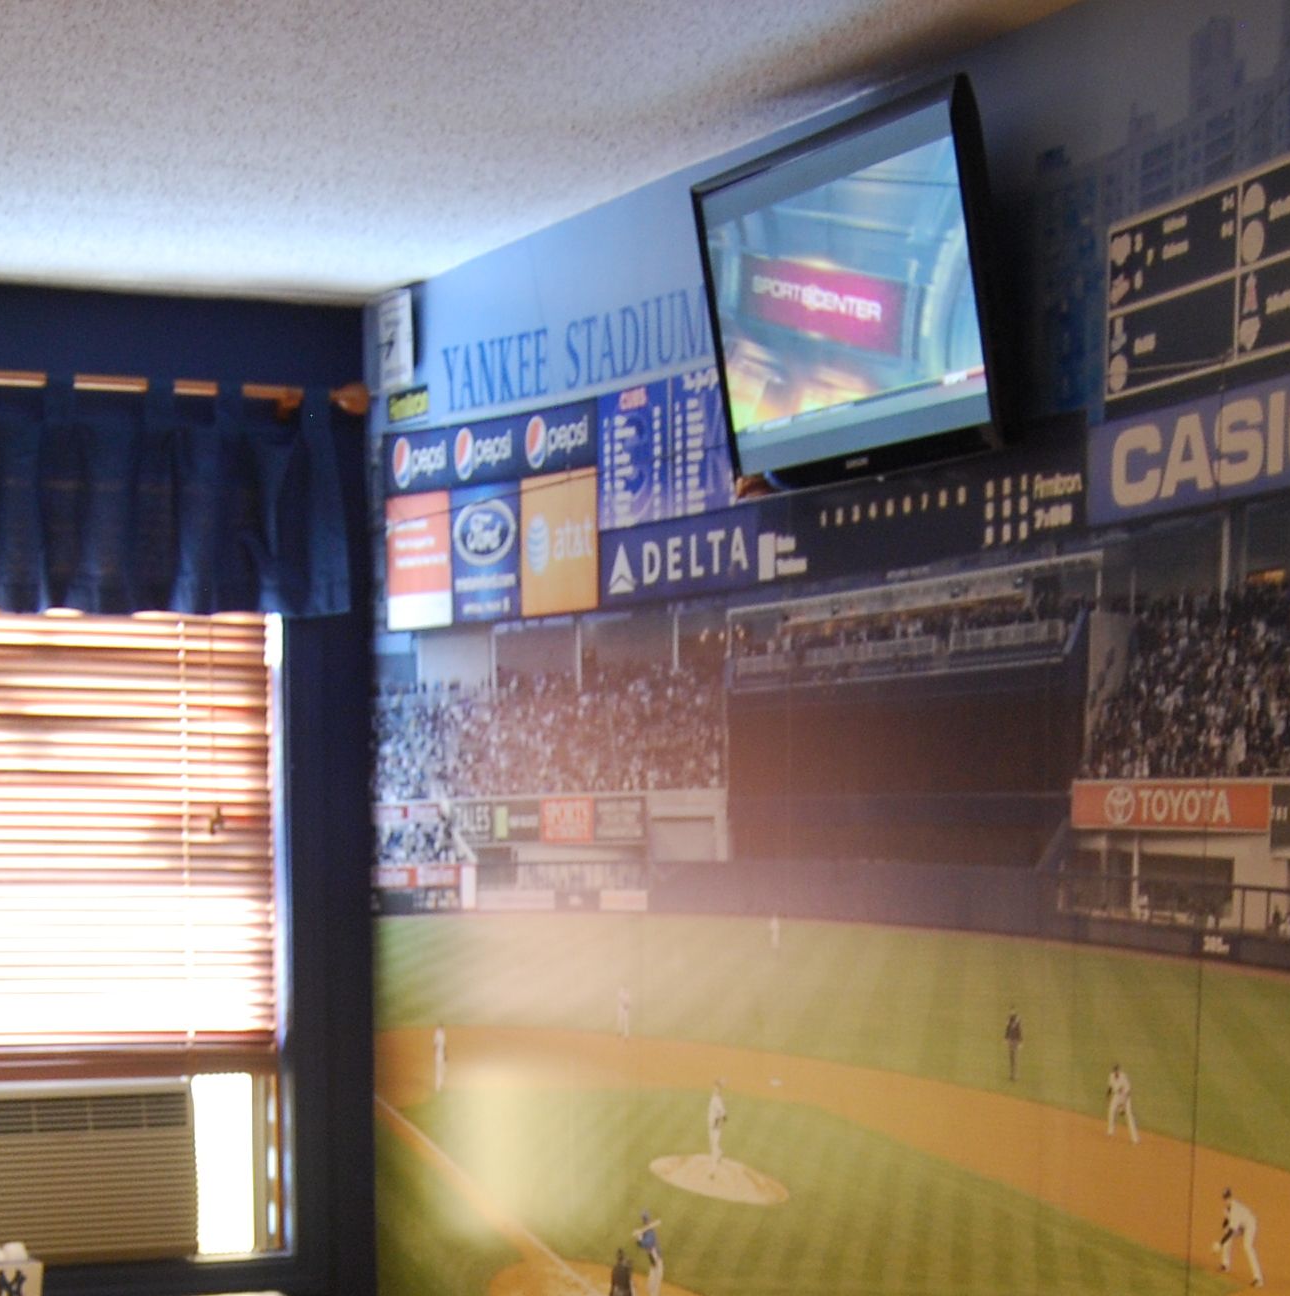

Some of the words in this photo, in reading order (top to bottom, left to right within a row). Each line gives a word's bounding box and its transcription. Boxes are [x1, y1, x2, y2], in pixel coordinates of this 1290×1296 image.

[442, 328, 548, 413] YANKEE
[565, 284, 713, 391] STADIUM
[473, 429, 512, 466] pepsi
[546, 415, 588, 452] pepsi
[410, 439, 447, 476] pepsi
[466, 512, 502, 552] Ford
[641, 525, 750, 586] DELTA
[1139, 788, 1232, 824] TOYOTA
